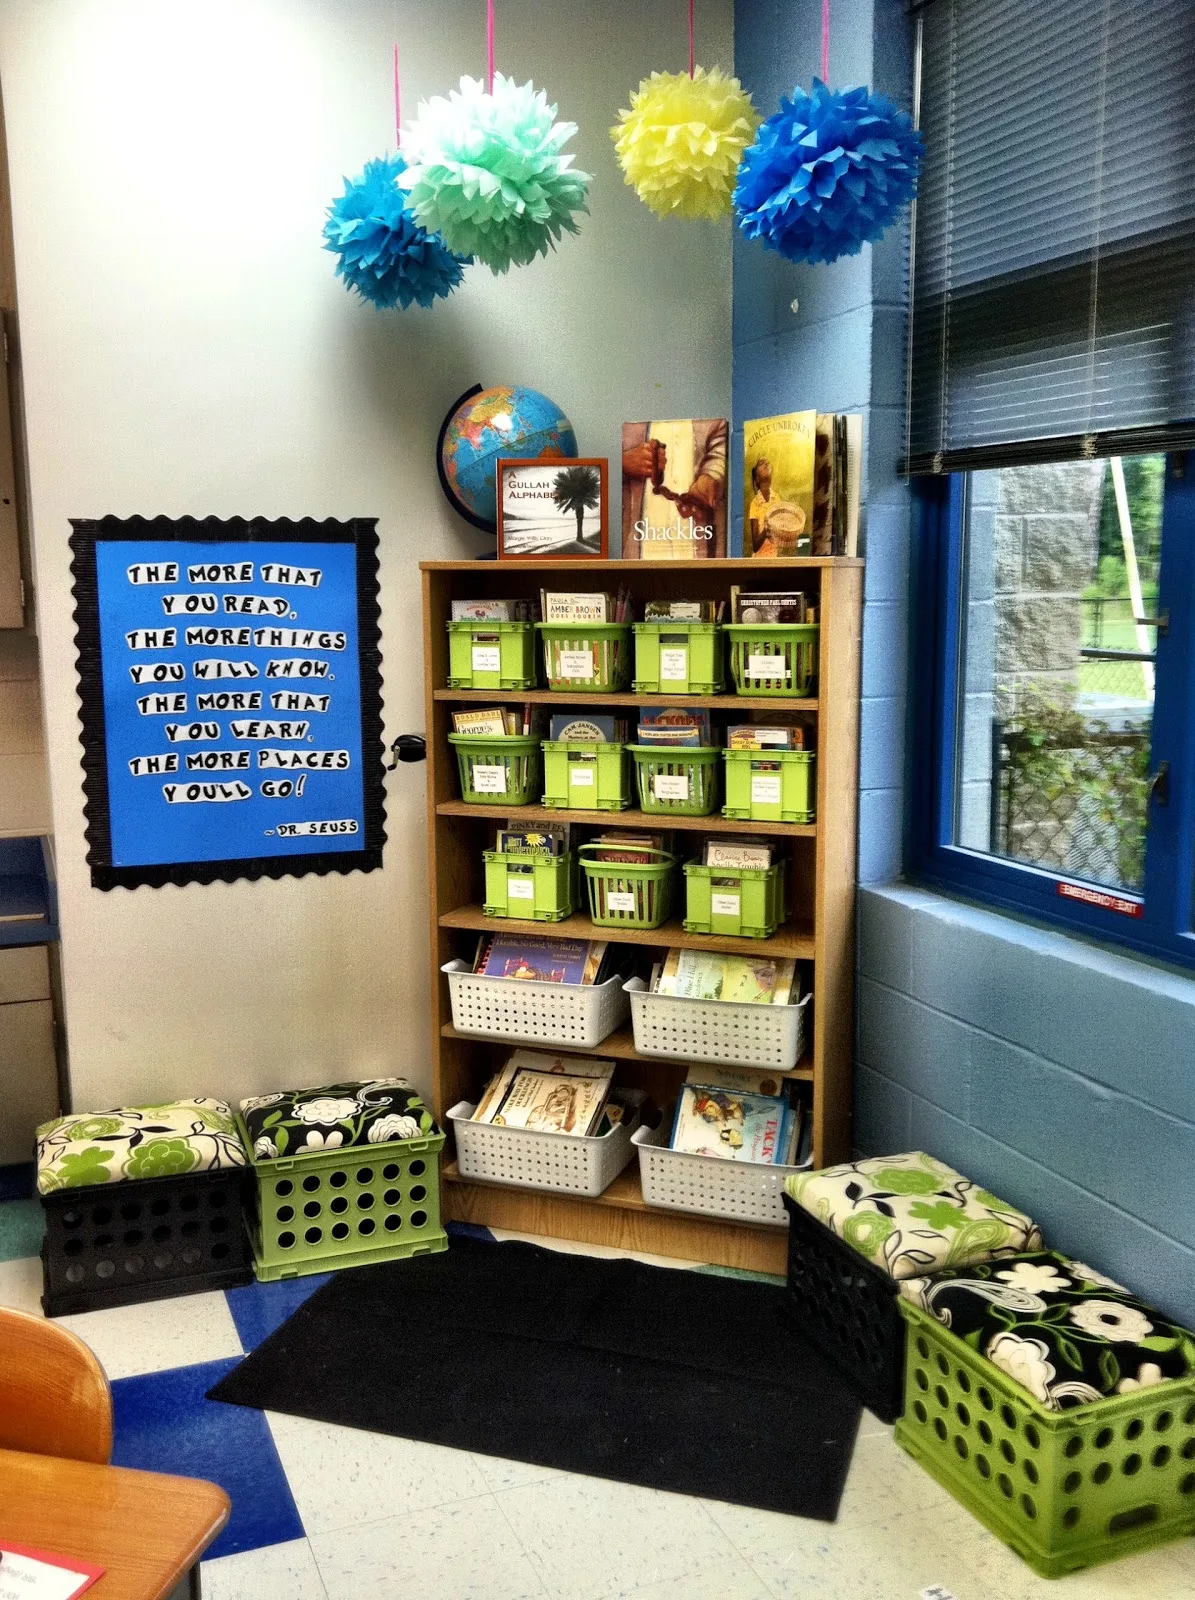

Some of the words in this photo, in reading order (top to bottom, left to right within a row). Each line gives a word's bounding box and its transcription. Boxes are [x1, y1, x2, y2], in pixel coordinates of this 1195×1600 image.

[748, 424, 771, 448] CIRCLE
[509, 471, 517, 479] A
[509, 480, 550, 489] GULLAH
[633, 515, 713, 541] Shackles
[129, 565, 177, 583] THE
[189, 564, 252, 582] MORE
[262, 566, 321, 586] THAT
[163, 596, 216, 613] YOU
[576, 606, 601, 614] BROWN
[128, 630, 176, 648] THE
[187, 628, 250, 645] MORE
[255, 630, 345, 649] THINGS
[131, 666, 184, 683] YOU
[195, 662, 258, 678] WILL
[267, 661, 335, 680] KNOW.
[138, 694, 186, 714] THE
[198, 693, 261, 710] MORE
[271, 694, 330, 711] THAT
[166, 723, 218, 742] YOU
[565, 725, 577, 735] CAM
[578, 723, 600, 735] JANSEN
[130, 755, 177, 775] THE
[187, 751, 250, 768] MORE
[259, 751, 348, 769] PLACES
[164, 784, 249, 801] YOU'LL
[262, 775, 306, 796] GO!
[309, 821, 356, 833] SEUSS
[536, 821, 550, 829] and
